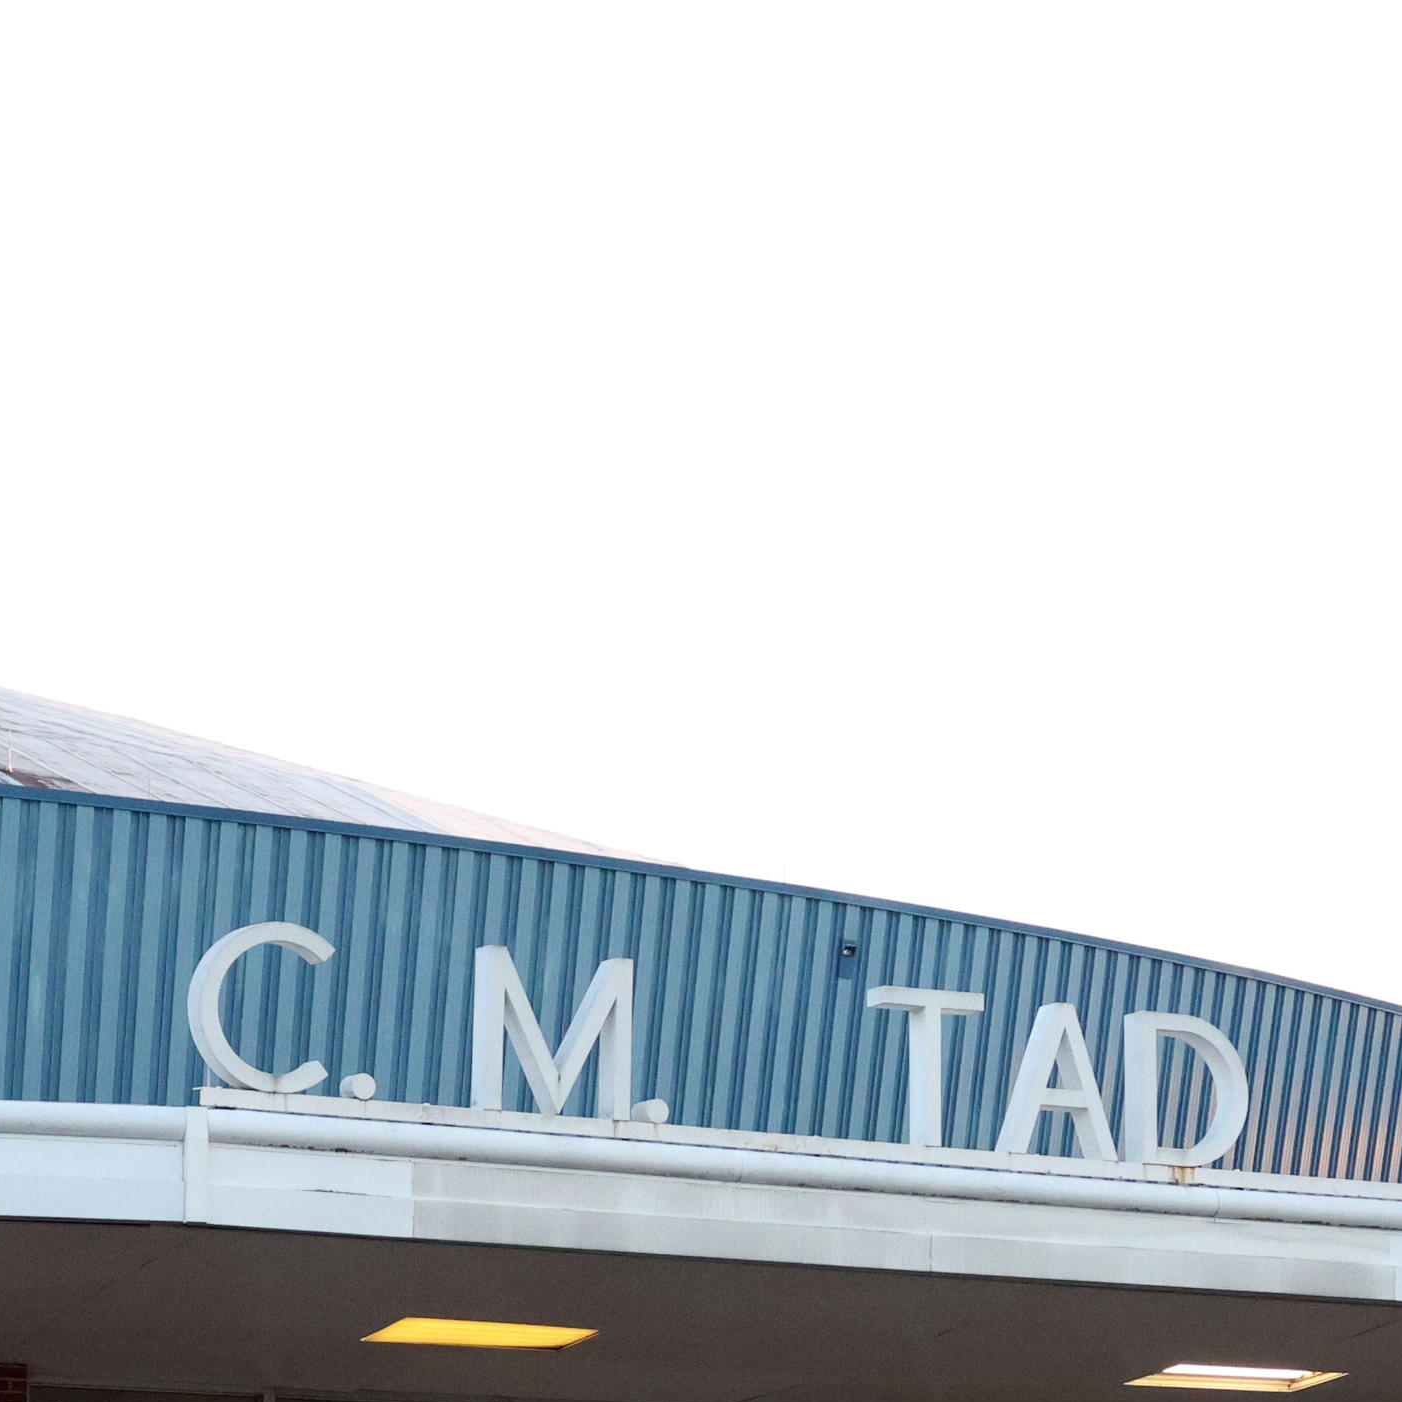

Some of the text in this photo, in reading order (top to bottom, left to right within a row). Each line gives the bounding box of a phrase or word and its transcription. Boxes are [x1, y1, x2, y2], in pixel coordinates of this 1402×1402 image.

[187, 920, 376, 1100] C.
[471, 944, 669, 1123] M.
[866, 985, 1249, 1167] TAD
